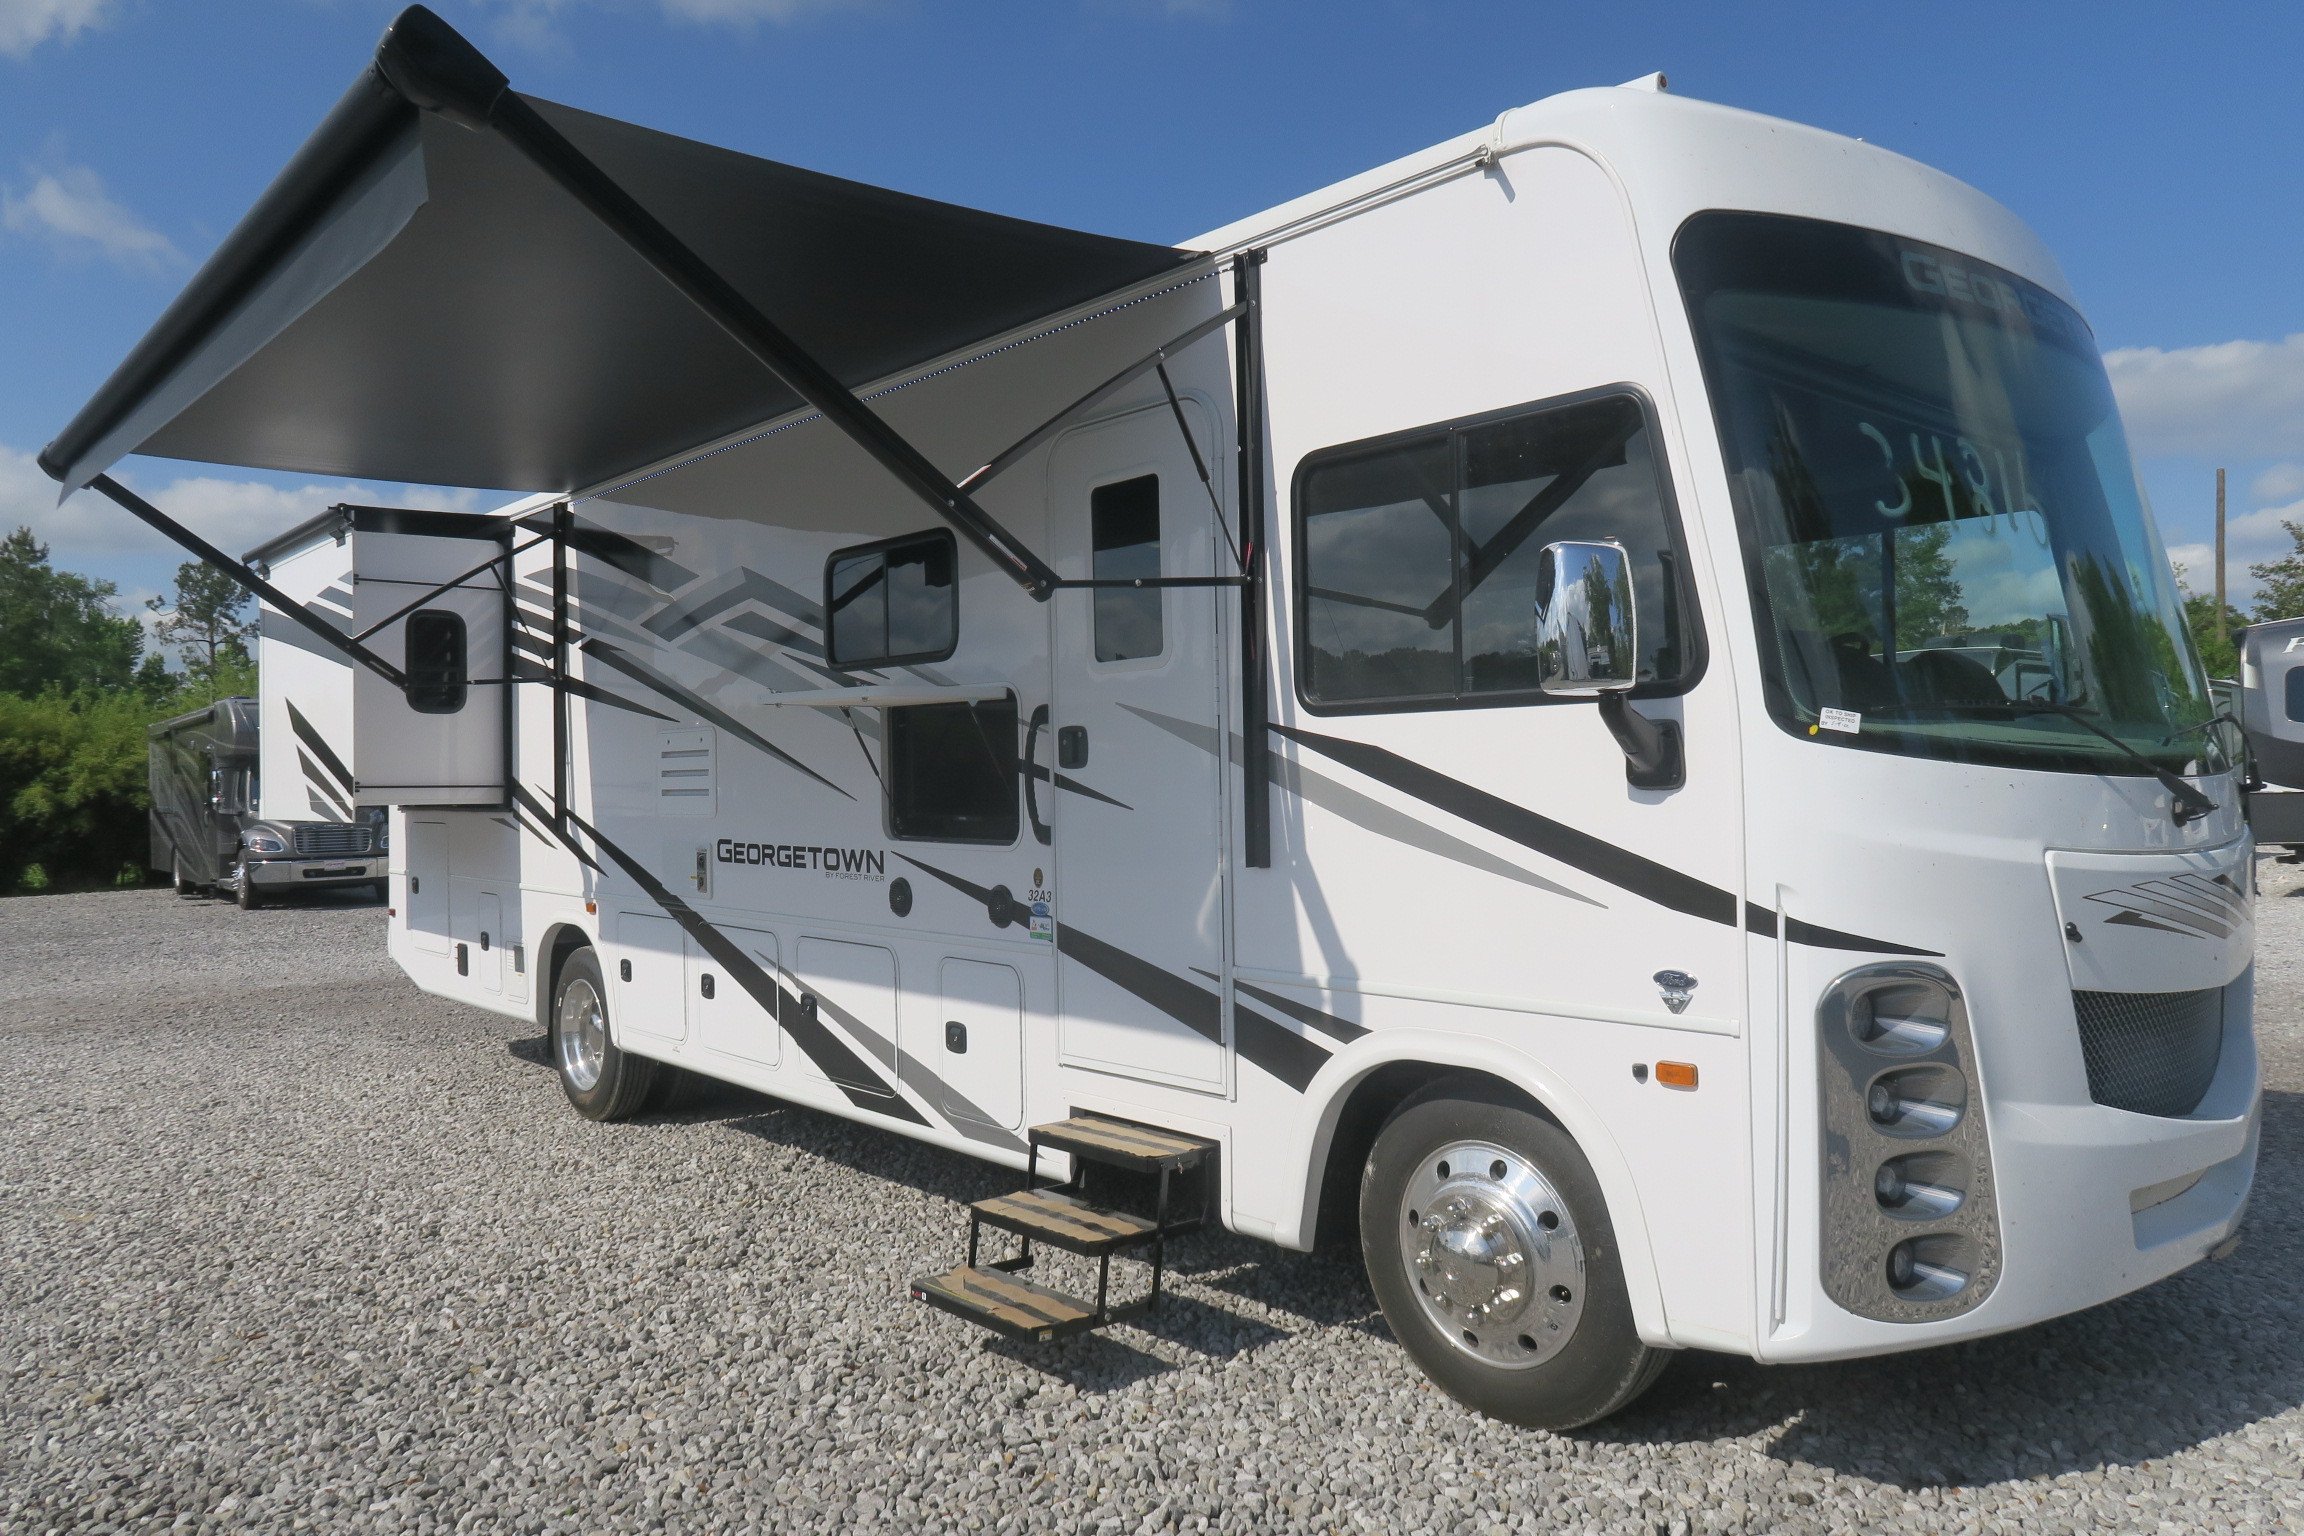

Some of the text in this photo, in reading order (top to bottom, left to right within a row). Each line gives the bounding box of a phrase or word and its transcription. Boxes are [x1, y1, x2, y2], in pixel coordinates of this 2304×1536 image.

[717, 838, 885, 875] GEORGETOWN
[825, 871, 885, 882] BY FOREST RIVER
[1027, 889, 1052, 903] 32A3
